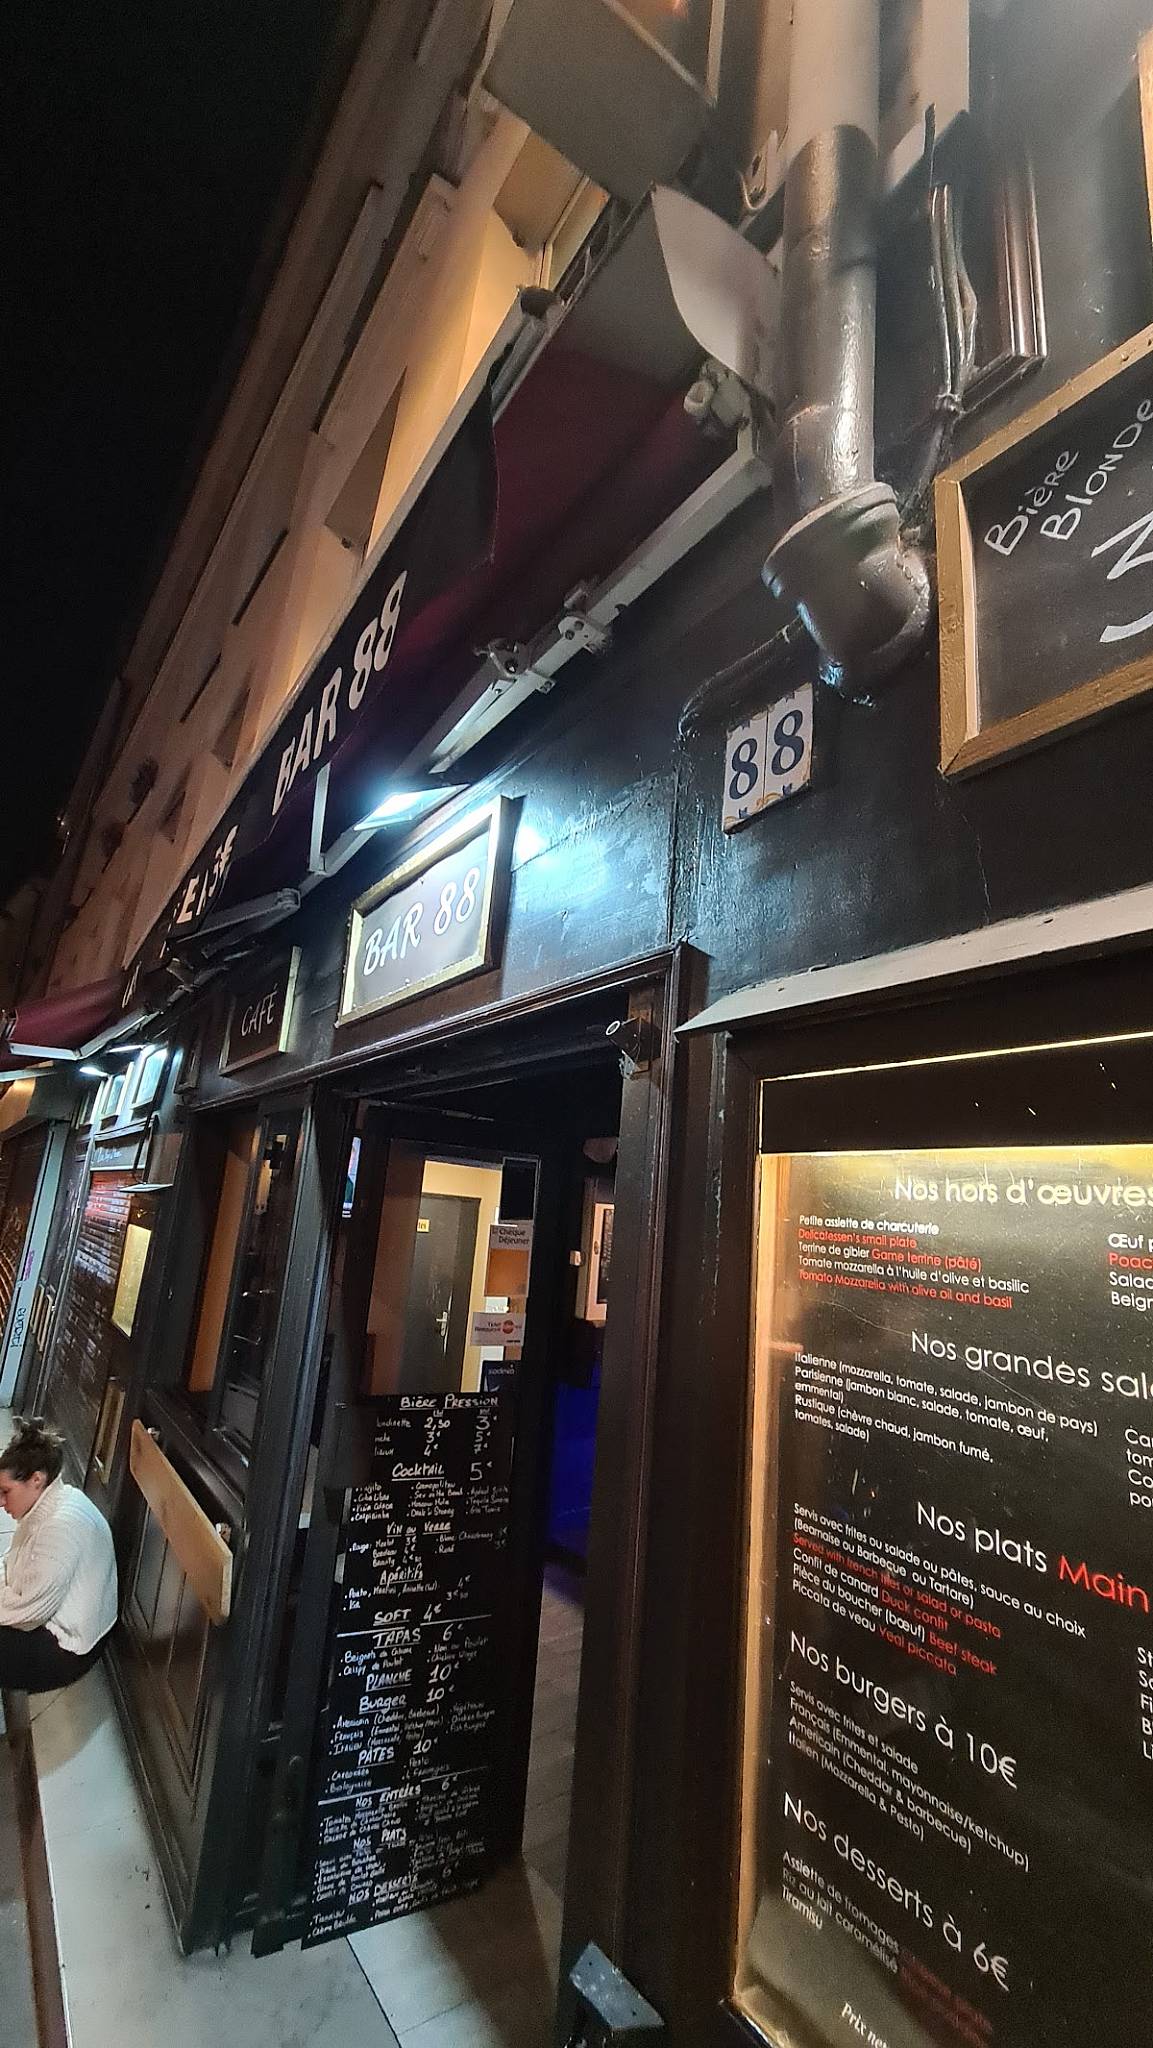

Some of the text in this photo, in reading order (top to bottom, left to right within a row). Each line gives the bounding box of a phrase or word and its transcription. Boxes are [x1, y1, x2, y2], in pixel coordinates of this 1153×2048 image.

[272, 569, 407, 817] BAR 88
[729, 709, 805, 800] 88
[362, 865, 481, 977] BAR 88
[799, 1215, 940, 1235] Petite assiette de charcuterie
[894, 1178, 939, 1202] Nos
[945, 1178, 998, 1203] hors
[798, 1228, 917, 1248] Delicatessen's small plate
[798, 1241, 982, 1273] Terrine de gibier Game terrine (pâté)
[799, 1255, 1030, 1294] Tomate mozzarella à l'huile d'olive et basilic
[1108, 1232, 1144, 1249] Œuf
[799, 1269, 1012, 1308] Tomato Mozzarella with olive oil and basil
[795, 1382, 844, 1403] emmental)
[795, 1352, 1098, 1437] Italienne (mozzarella, tomate, salade, jambon de pays)
[911, 1330, 1153, 1400] Nos grandes sal
[795, 1366, 1048, 1442] Parisienne (jambon blanc, salade, tomate, œuf,
[795, 1409, 870, 1443] tomates, salade)
[795, 1394, 994, 1463] Rustique (chèvre chaud, jambon fumé,
[793, 1532, 1001, 1639] Served with french or salad or pasta
[794, 1503, 1086, 1639] Servis avec frites ou salade ou pâtes, sauce au choix
[794, 1547, 948, 1631] Confit de canard Duck confit
[842, 1541, 855, 1553] ou
[857, 1545, 906, 1576] Barbecue
[912, 1572, 926, 1585] ou
[929, 1576, 974, 1610] Tartare)
[917, 1501, 1149, 1613] Nos plats Main
[373, 1628, 421, 1646] TAPAS
[375, 1609, 412, 1623] SOFT
[792, 1579, 957, 1677] Piccata de veau Veal piccata
[793, 1563, 998, 1676] Pièce du boucher (bœuf) Beef steak
[366, 1669, 413, 1691] PLANCHE
[790, 1630, 1018, 1790] Nos burgers à 10€
[790, 1681, 919, 1774] Servis avec frites et salade
[788, 1730, 924, 1842] Italien (Mozzarella Pesto)
[790, 1697, 830, 1734] Français
[892, 1769, 1029, 1872] mayonnaise/ketchup)
[843, 1752, 893, 1796] (Cheddar
[907, 1797, 971, 1855] barbecue)
[782, 1850, 824, 1889] Assiette
[827, 1883, 842, 1904] de
[845, 1896, 899, 1954] fromages
[782, 1884, 823, 1930] Tiramisu
[784, 1791, 1010, 1991] Nos desserts à 6€
[799, 1881, 814, 1901] au
[817, 1894, 832, 1917] lait
